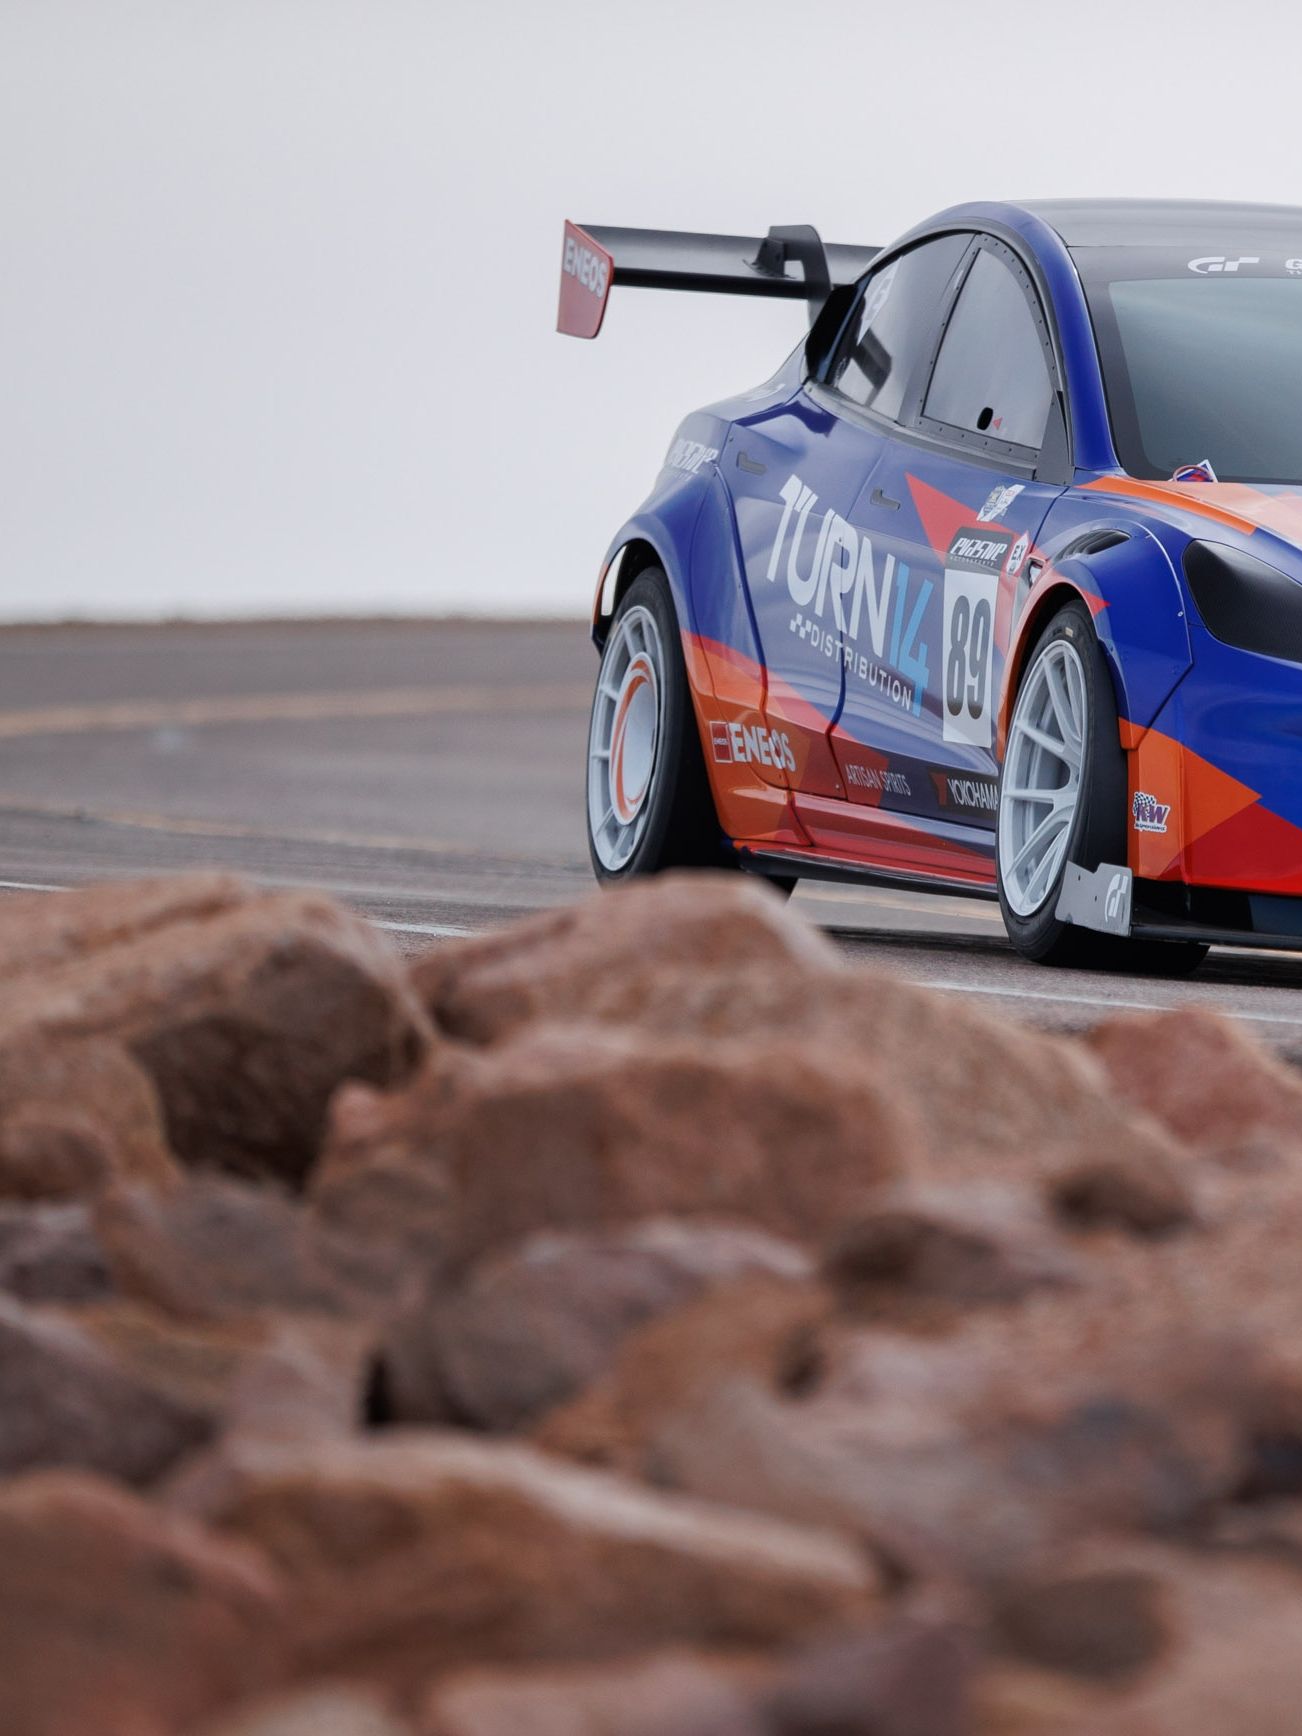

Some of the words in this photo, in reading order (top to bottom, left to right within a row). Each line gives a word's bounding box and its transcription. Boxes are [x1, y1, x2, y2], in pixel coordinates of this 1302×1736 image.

[563, 236, 608, 299] ENEOS
[810, 623, 913, 711] DISTRIBUTION
[946, 595, 991, 720] 89
[728, 722, 796, 772] ENEOS
[846, 765, 883, 789] ARTISAN
[880, 770, 912, 796] SPIRITS
